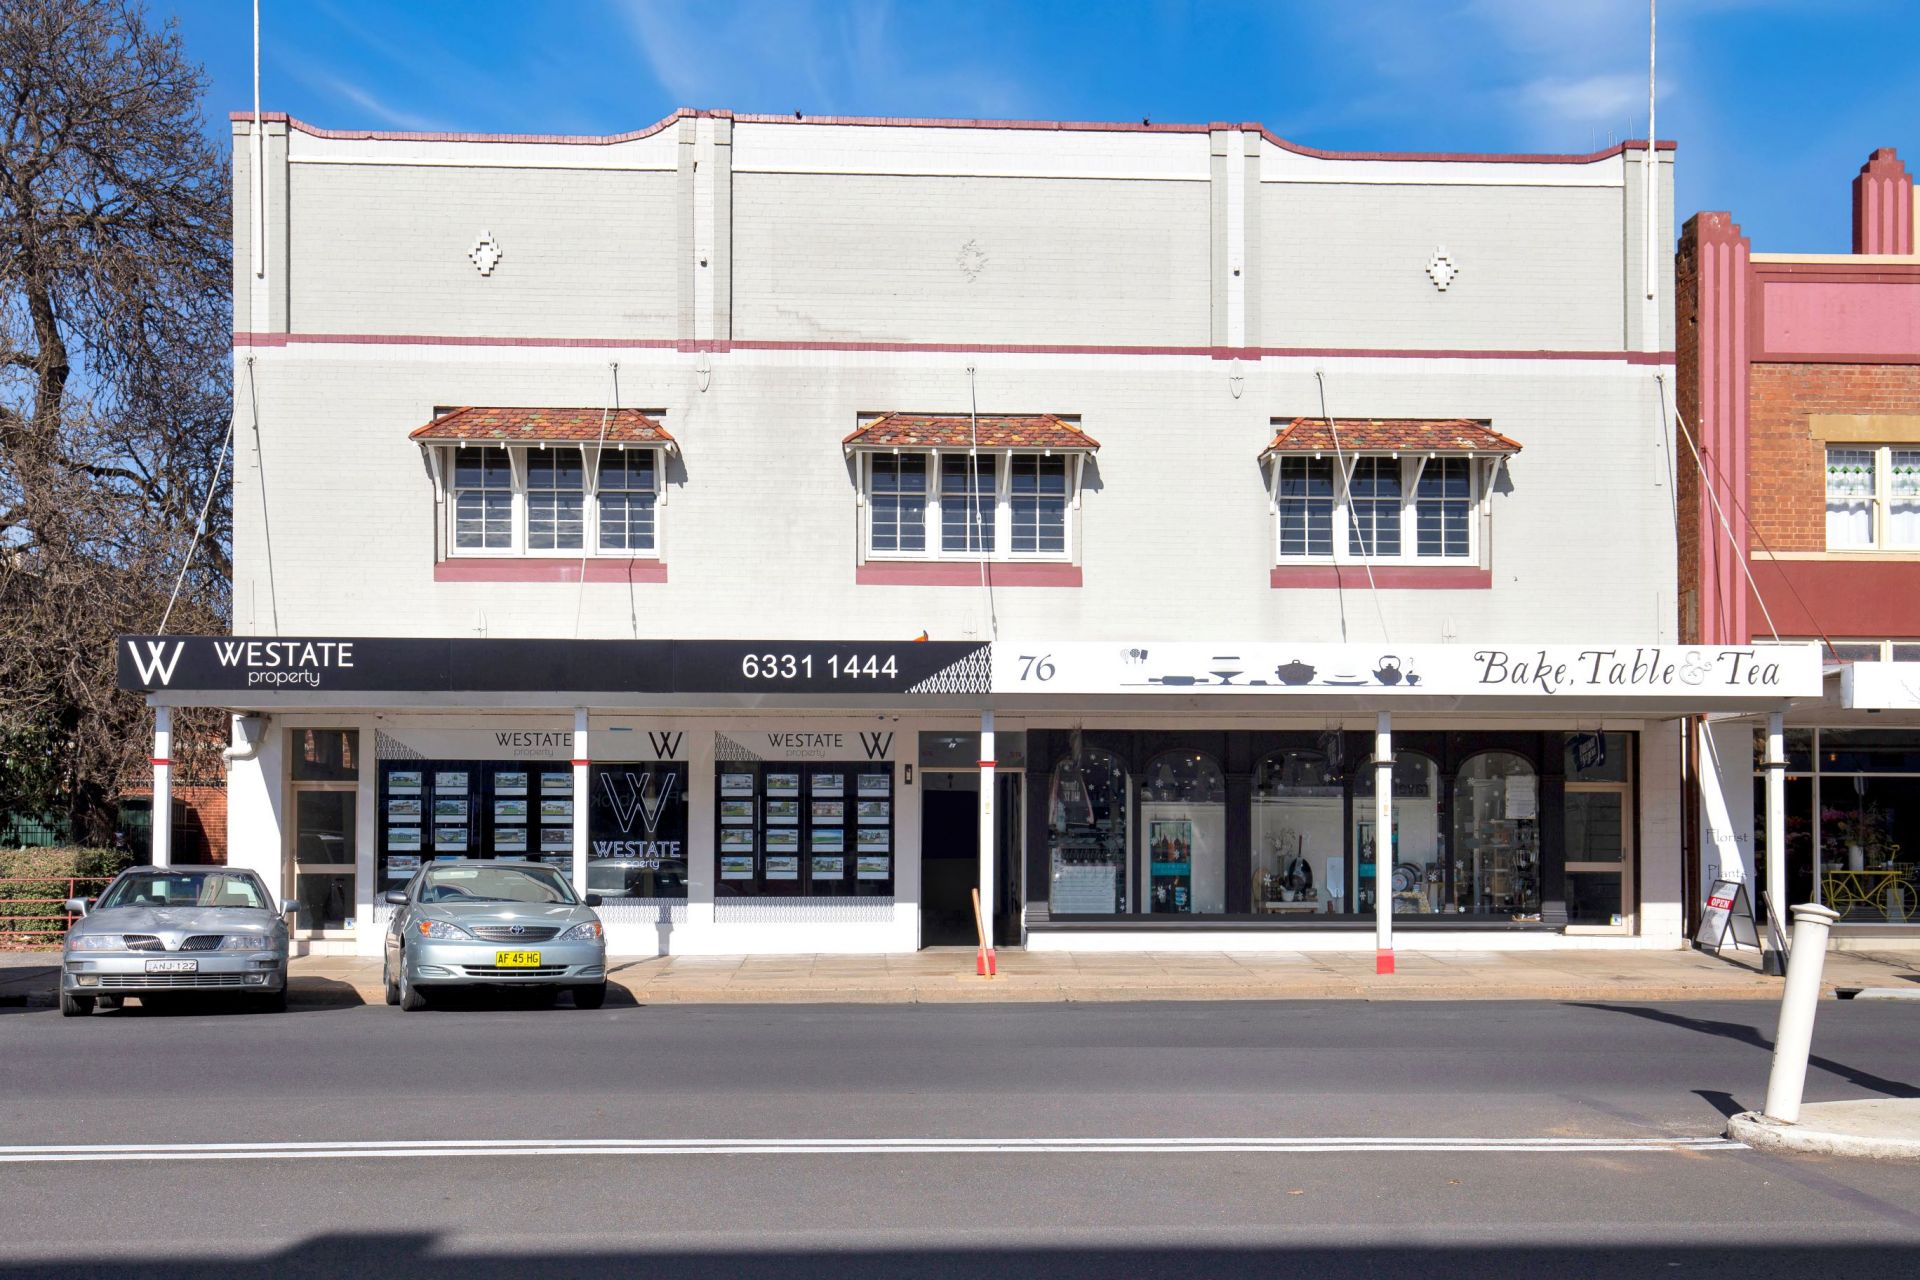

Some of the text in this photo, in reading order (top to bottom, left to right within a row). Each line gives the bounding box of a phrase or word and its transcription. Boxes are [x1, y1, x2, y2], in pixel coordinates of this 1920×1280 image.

[213, 641, 354, 668] WESTATE
[742, 654, 899, 679] 6331 1444
[1018, 654, 1056, 682] 76
[1474, 650, 1575, 694] Bake,
[1577, 648, 1675, 685] Table
[1716, 650, 1780, 686] Tea
[248, 668, 320, 687] property
[495, 732, 573, 747] WESTATE
[767, 733, 843, 748] WESTATE
[514, 749, 554, 757] property
[786, 749, 826, 758] property
[1705, 828, 1750, 845] Florist
[592, 840, 681, 858] WESTATE
[614, 859, 660, 870] property
[1710, 897, 1730, 909] OPEN
